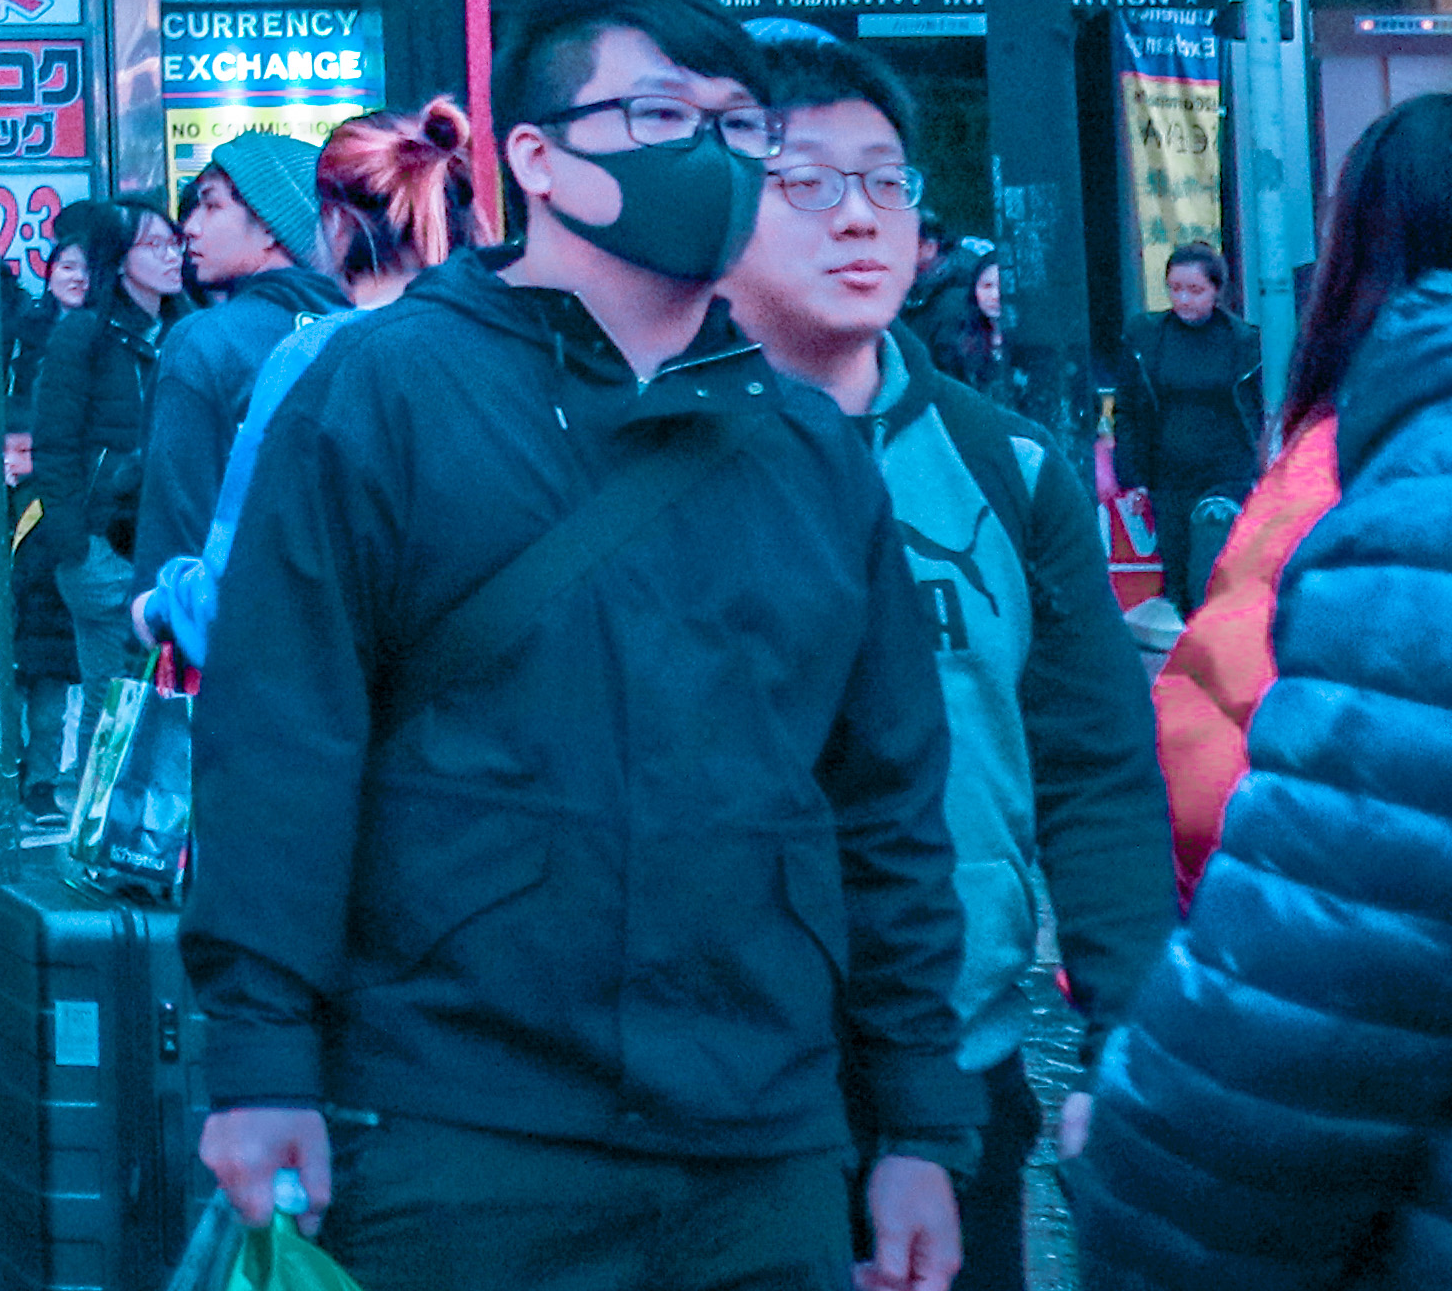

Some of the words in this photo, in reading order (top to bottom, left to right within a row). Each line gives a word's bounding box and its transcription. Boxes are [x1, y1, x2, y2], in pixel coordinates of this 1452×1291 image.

[163, 8, 359, 40] CURRENCY
[164, 50, 363, 83] EXCHANGE
[172, 121, 200, 139] NO
